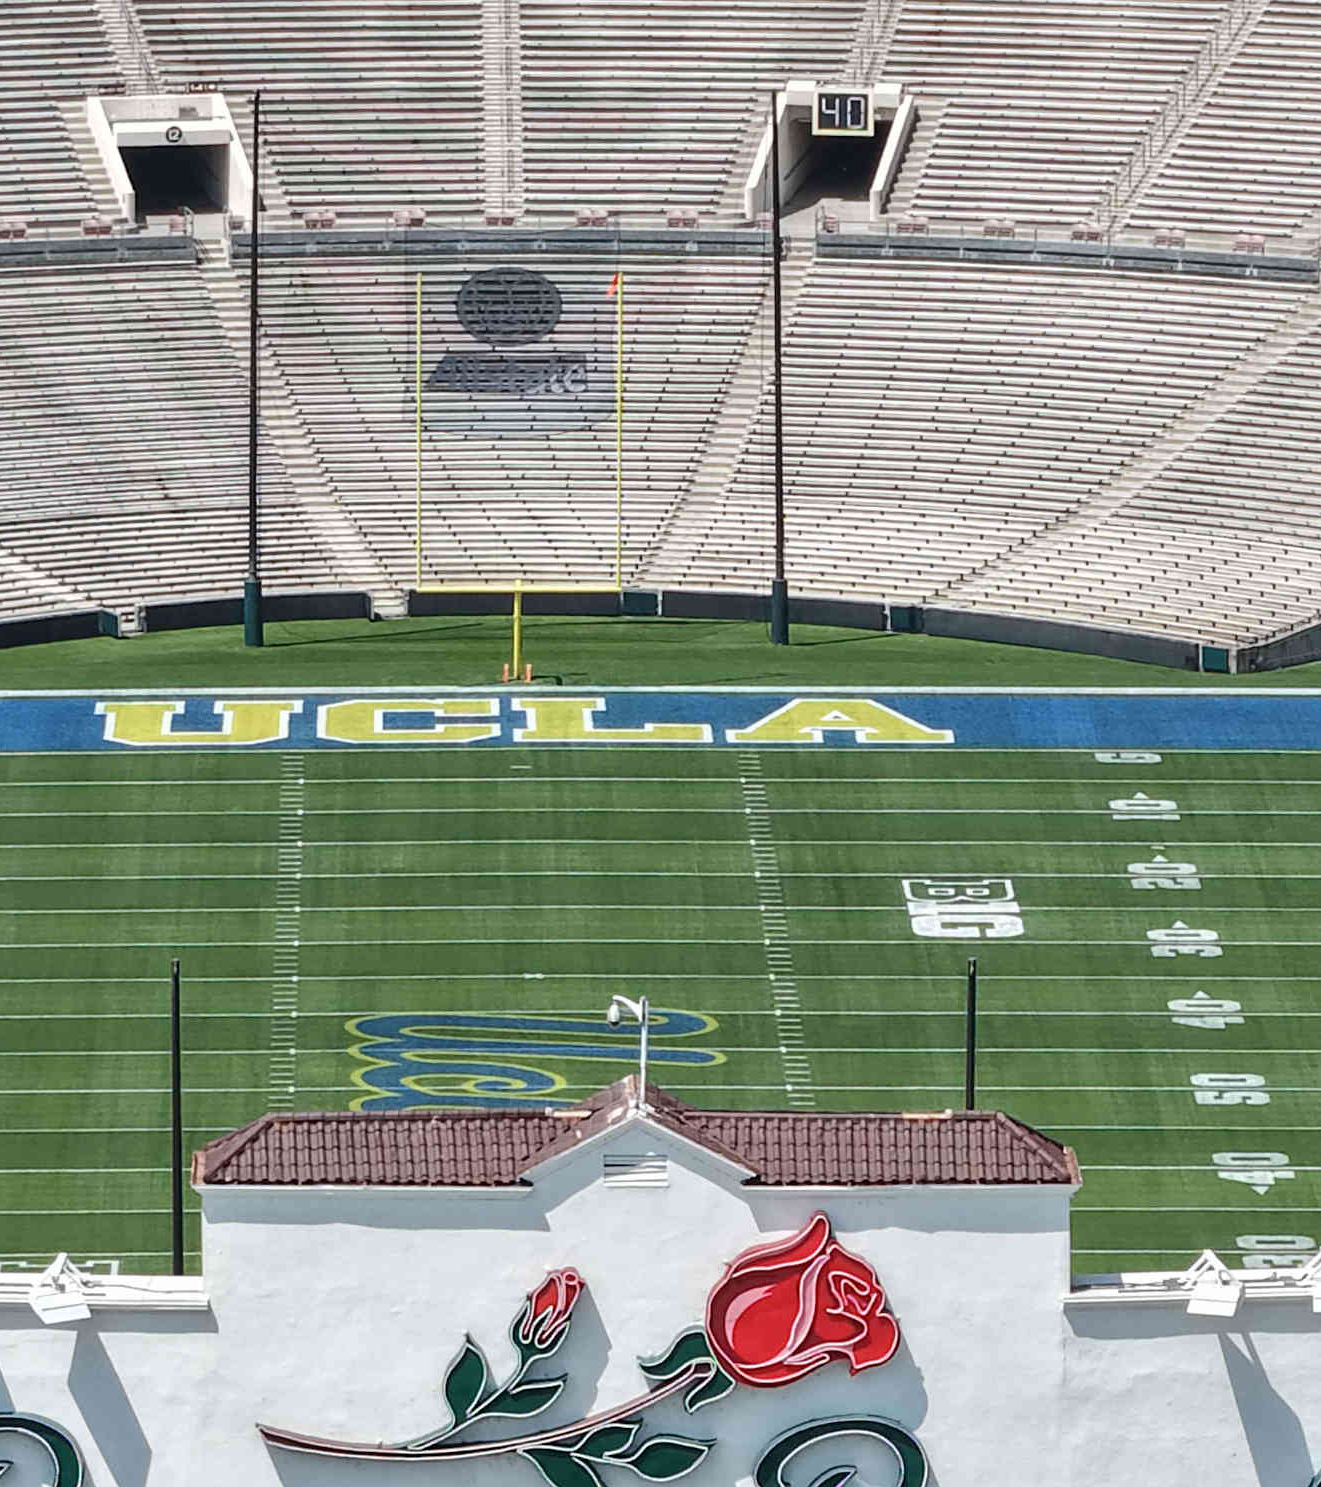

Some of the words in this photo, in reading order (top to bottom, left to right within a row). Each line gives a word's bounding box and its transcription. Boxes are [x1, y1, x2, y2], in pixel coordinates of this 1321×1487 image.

[821, 96, 866, 130] 40
[94, 697, 955, 746] UCLA
[1127, 862, 1203, 890] 20
[1145, 928, 1224, 958] 30
[1189, 1072, 1272, 1105] 50
